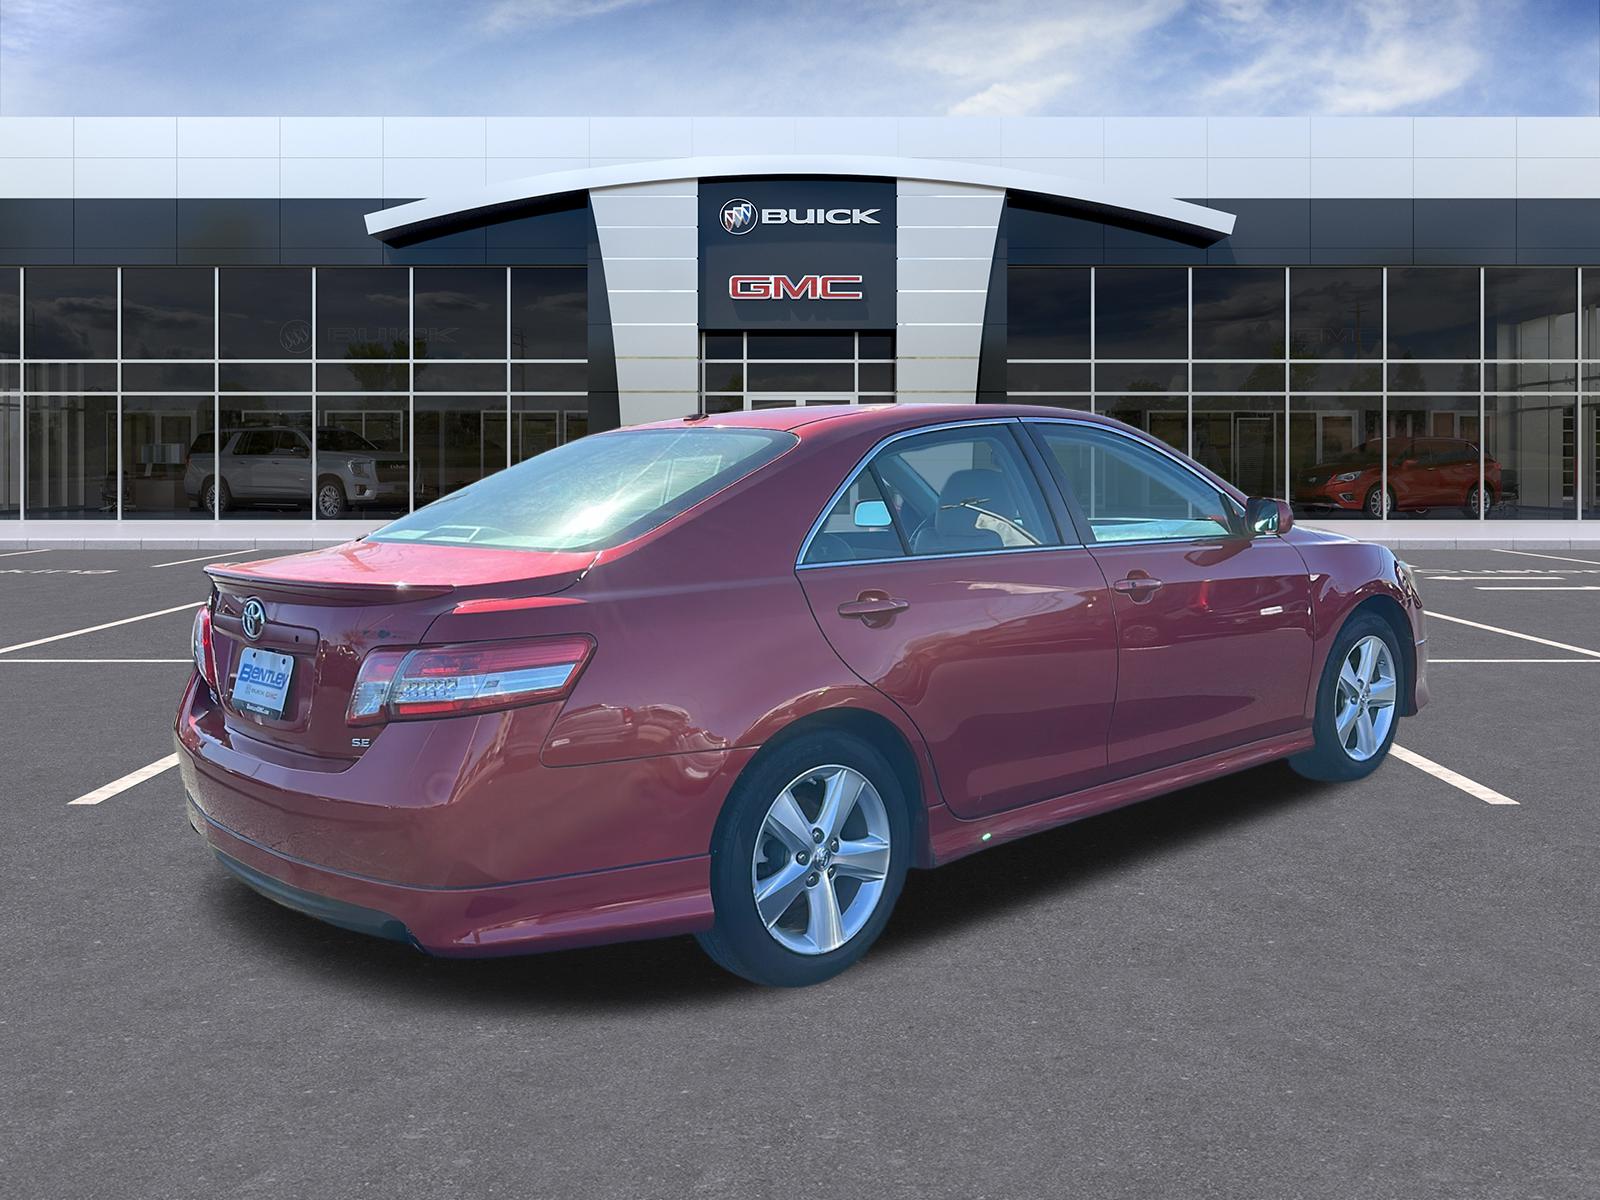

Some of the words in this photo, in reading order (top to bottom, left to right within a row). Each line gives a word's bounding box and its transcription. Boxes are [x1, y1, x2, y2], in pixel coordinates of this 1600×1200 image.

[761, 209, 881, 224] BUICK
[729, 275, 863, 299] GMC
[351, 738, 370, 747] SE
